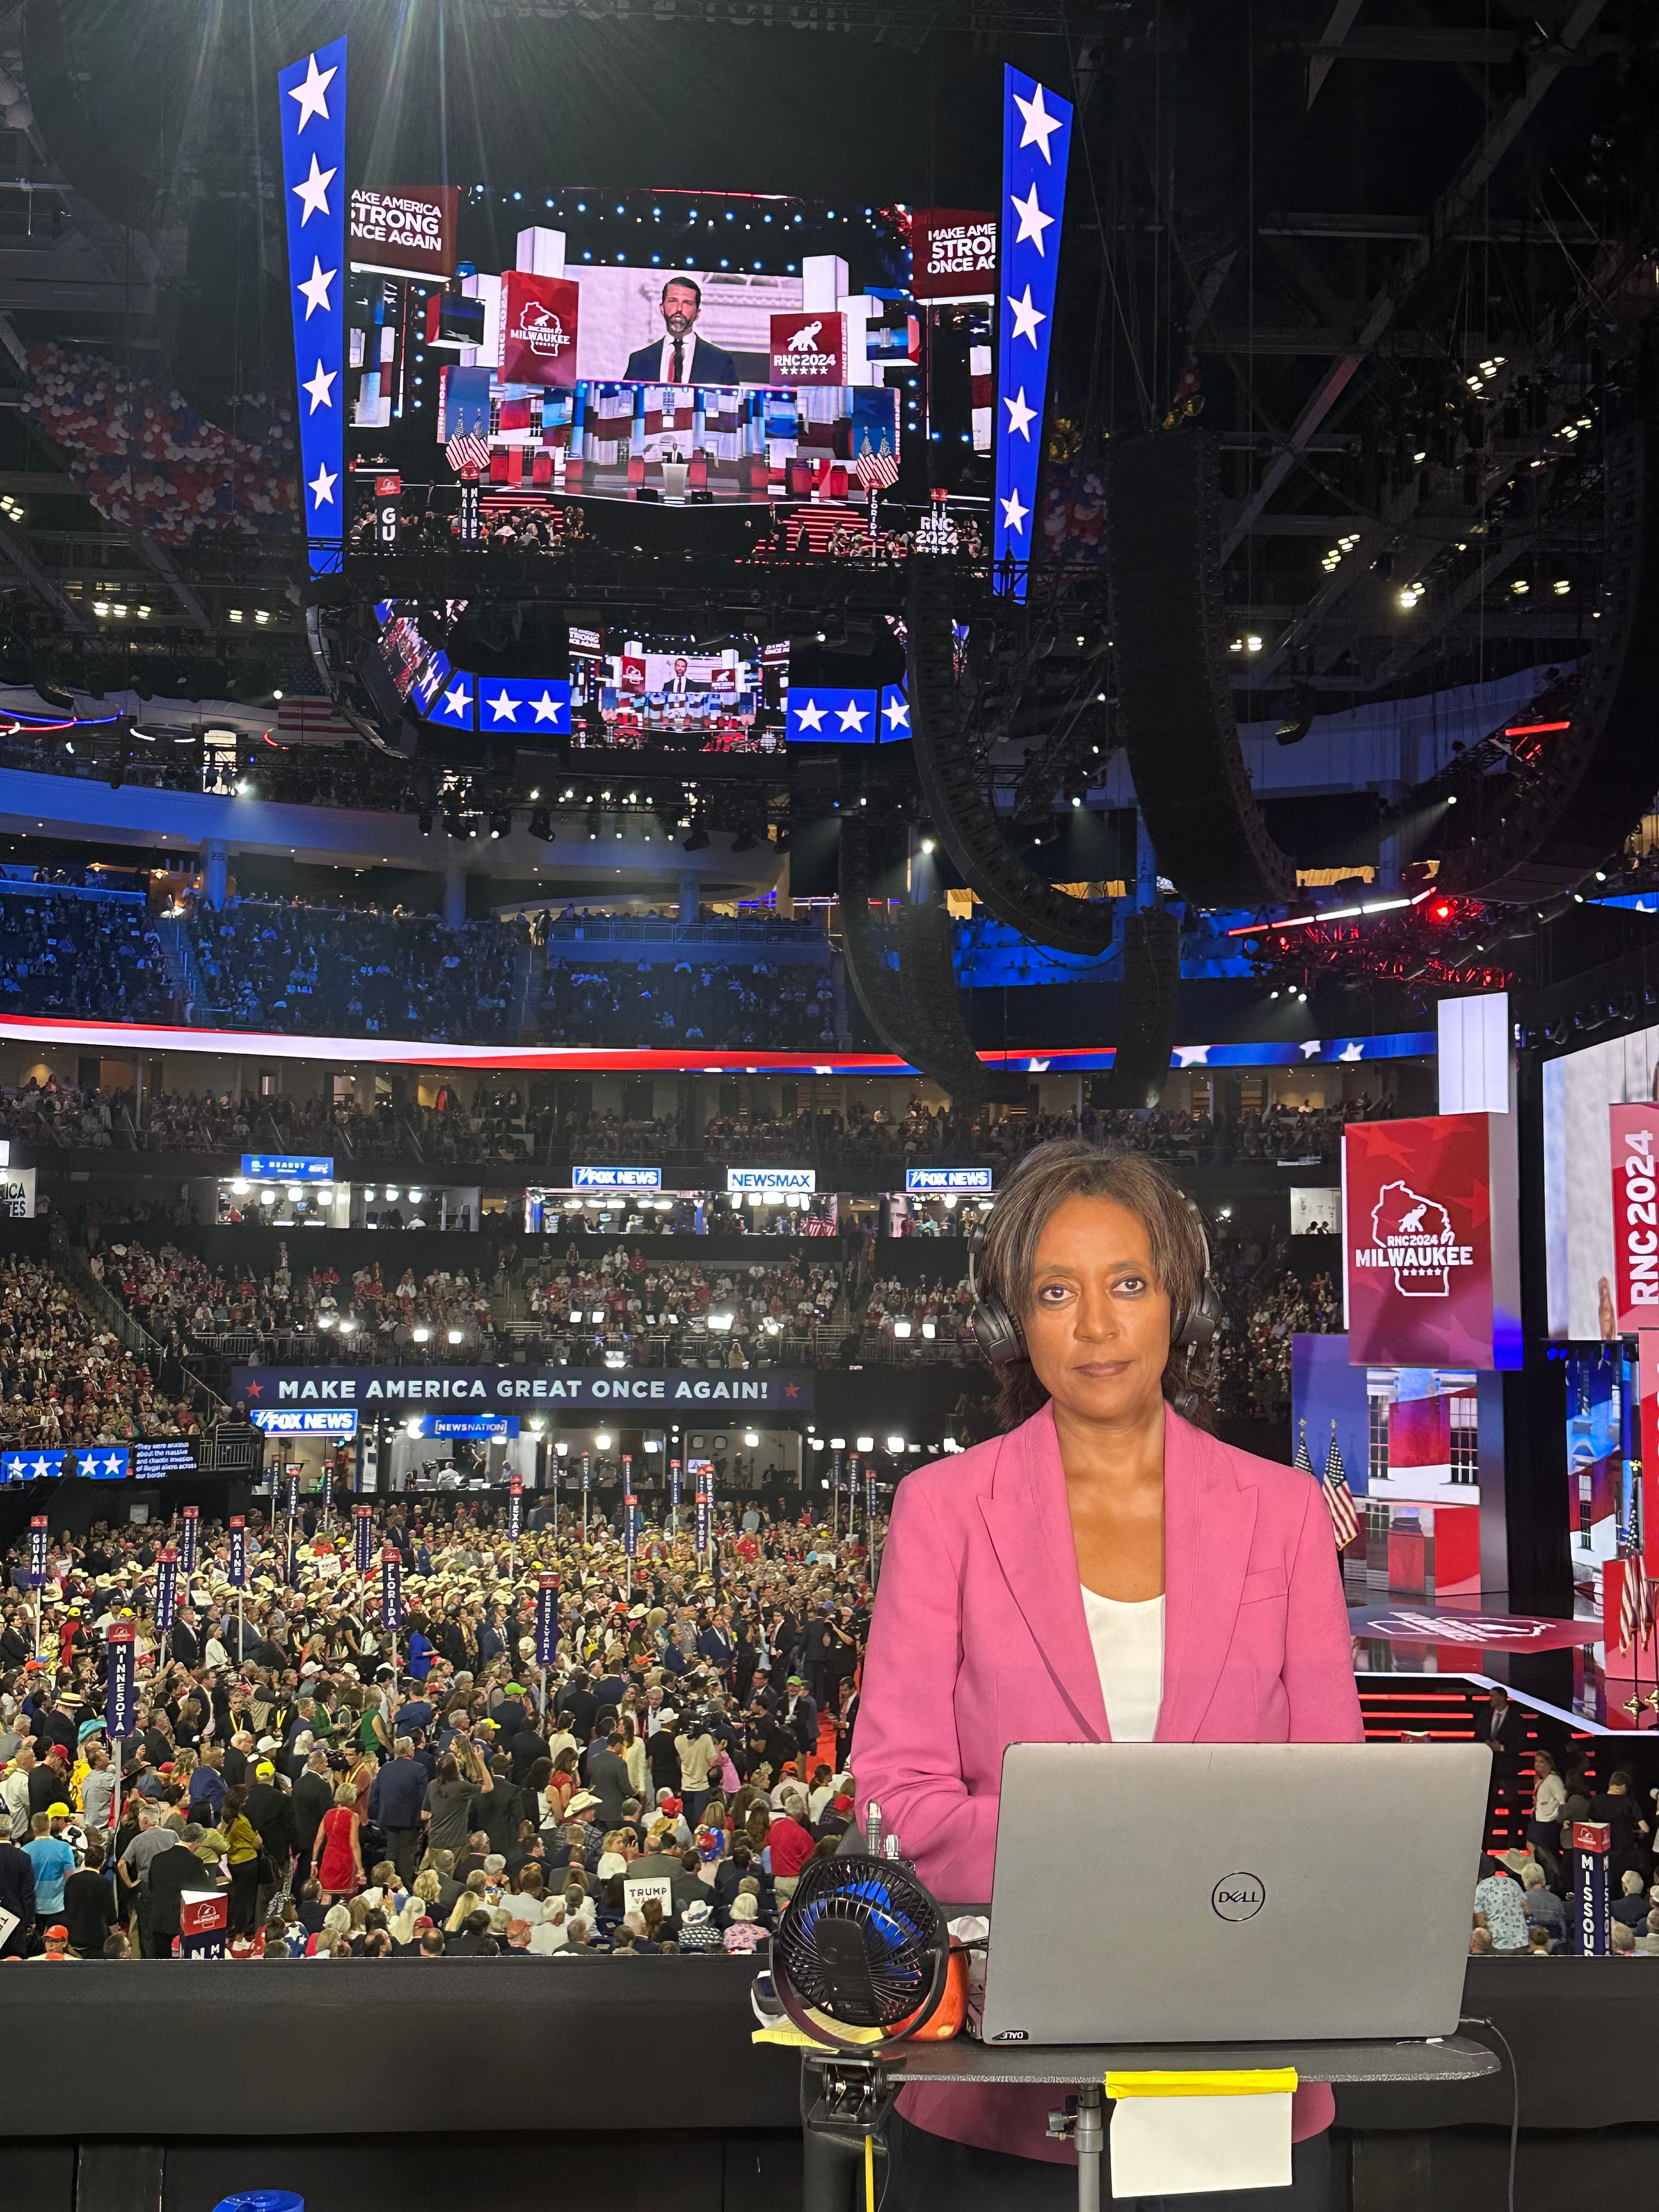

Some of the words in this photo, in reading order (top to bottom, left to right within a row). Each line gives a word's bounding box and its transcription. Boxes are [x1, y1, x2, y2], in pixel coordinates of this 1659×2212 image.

[381, 195, 442, 218] AMERICA
[388, 230, 442, 251] AGAIN
[928, 227, 966, 241] MAKE
[927, 257, 974, 274] ONCE
[510, 329, 571, 345] MILWAUKEE
[774, 354, 837, 366] RNC2024
[915, 530, 959, 545] 2024
[587, 1169, 617, 1185] FOX
[617, 1171, 658, 1185] NEWS
[732, 1173, 810, 1187] NEWSMAX
[920, 1171, 948, 1187] FOX
[949, 1171, 988, 1186] NEWS
[1625, 1130, 1658, 1305] RNC2024
[1387, 1234, 1438, 1246] RNC2024
[1356, 1246, 1474, 1267] MILWAUKEE
[279, 1381, 356, 1398] MAKE
[366, 1380, 486, 1398] AMERICA
[497, 1380, 582, 1397] GREAT
[592, 1381, 664, 1397] ONCE
[675, 1381, 767, 1398] AGAIN!
[267, 1413, 303, 1431] FOX
[304, 1413, 353, 1429] NEWS
[511, 1497, 520, 1537] TEXAS
[32, 1534, 41, 1575] GUAM
[233, 1534, 241, 1576] MAINE
[157, 1564, 166, 1627] INDIANA
[387, 1563, 397, 1626] FLORIDA
[115, 1644, 127, 1731] MINNESOTA
[629, 1887, 667, 1898] TRUMP
[1218, 1891, 1260, 1903] DELL
